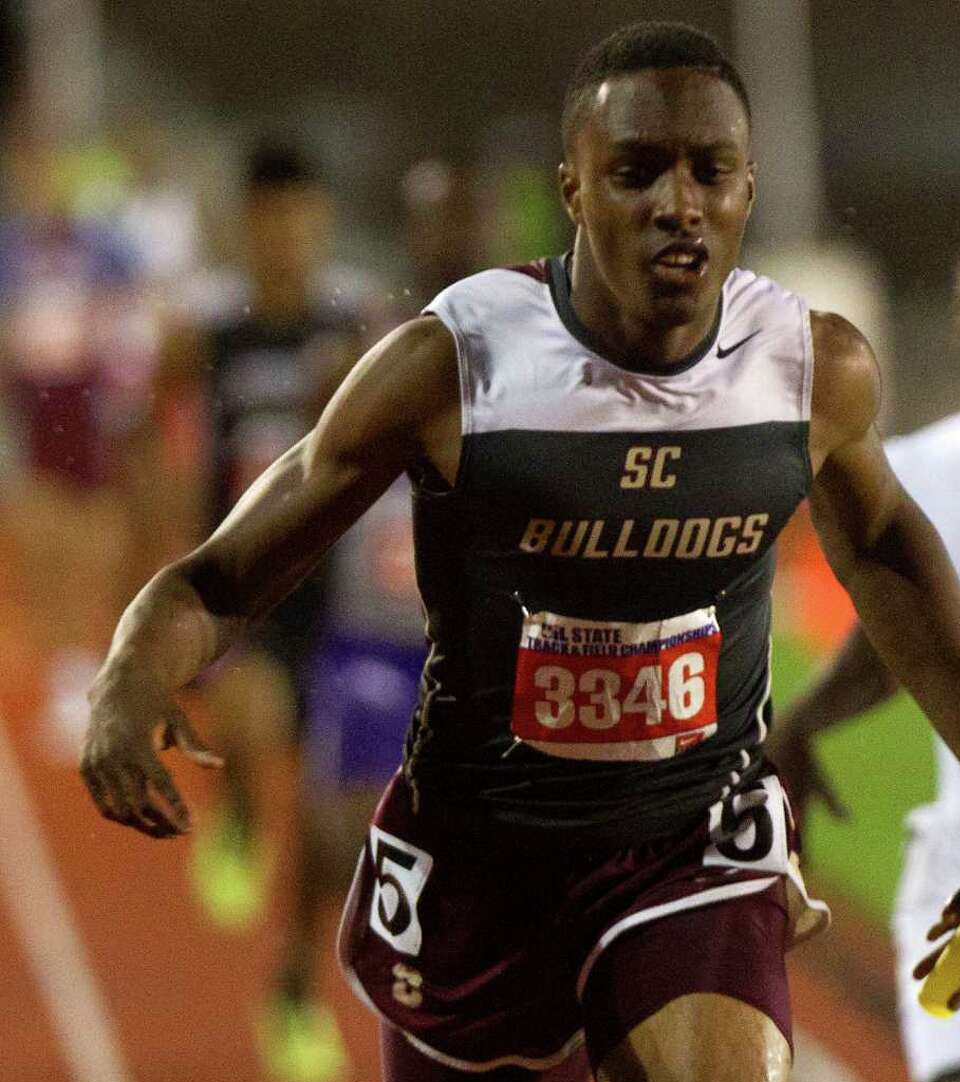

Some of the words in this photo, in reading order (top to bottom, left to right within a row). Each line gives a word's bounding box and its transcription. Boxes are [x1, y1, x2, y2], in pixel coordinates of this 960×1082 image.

[620, 446, 681, 488] SC
[519, 513, 769, 558] BULLDOGS
[571, 627, 622, 643] STATE
[533, 651, 706, 730] 3346
[714, 780, 774, 863] 5
[374, 837, 419, 937] 5
